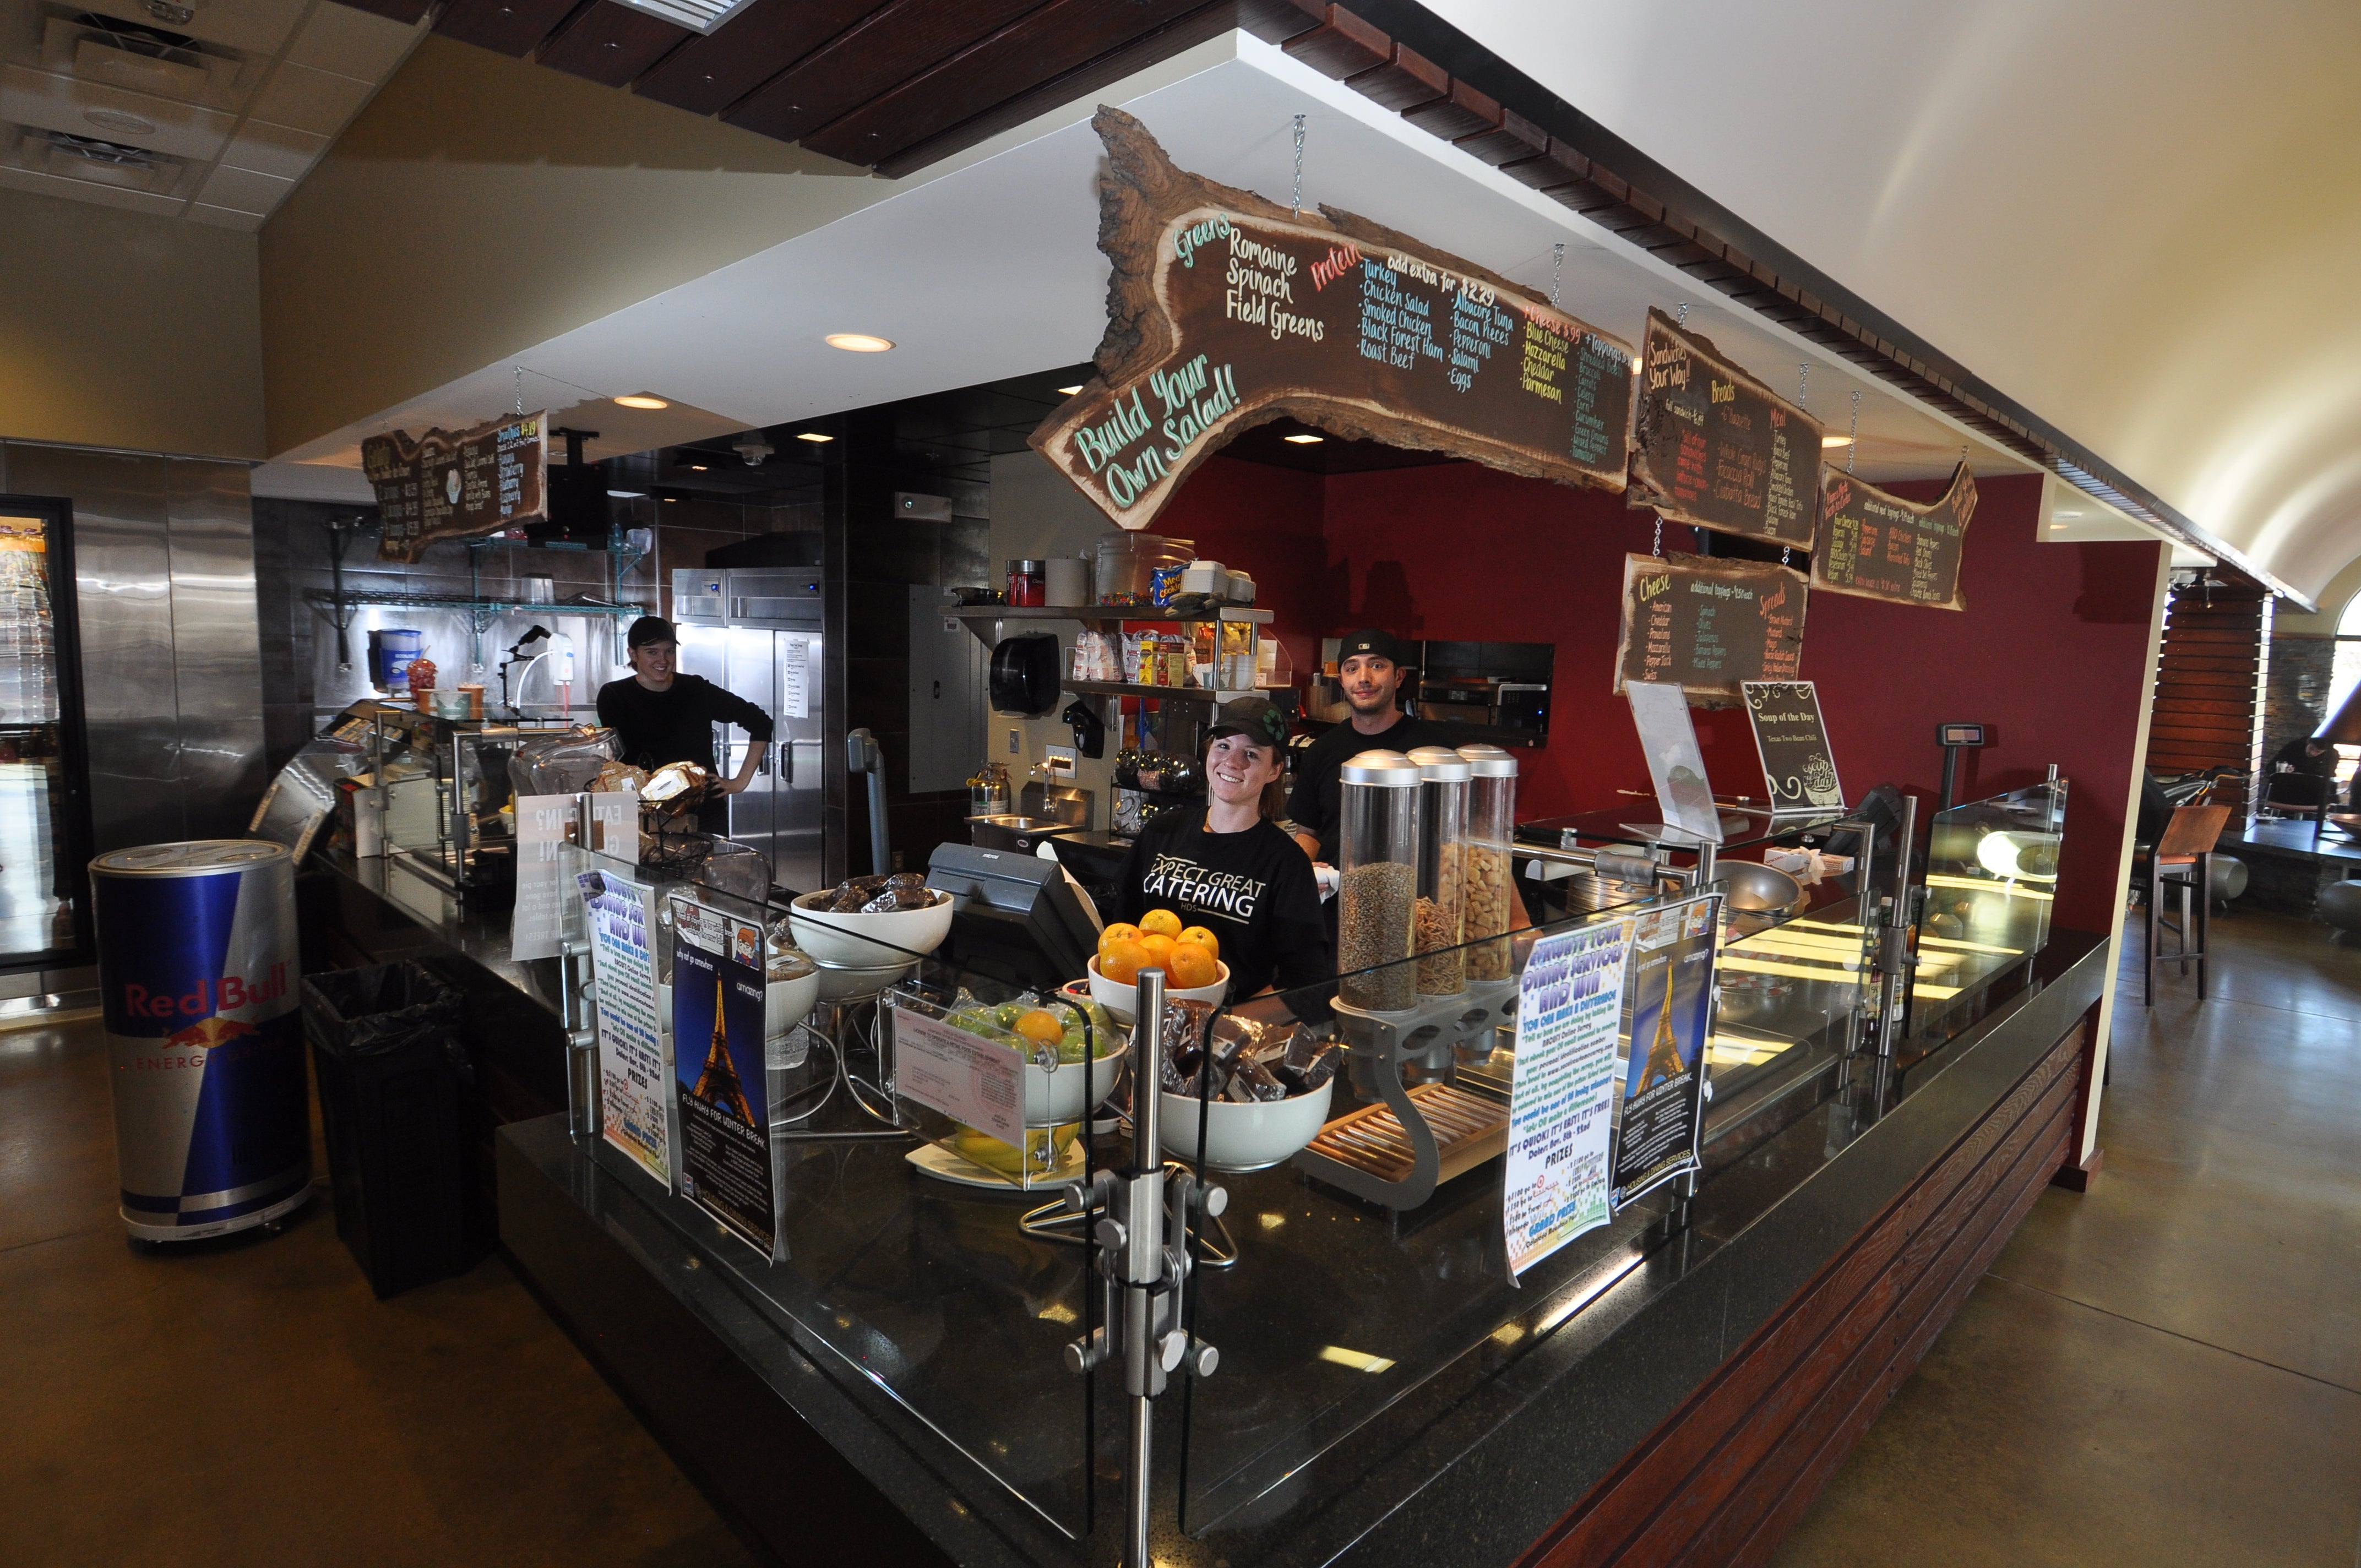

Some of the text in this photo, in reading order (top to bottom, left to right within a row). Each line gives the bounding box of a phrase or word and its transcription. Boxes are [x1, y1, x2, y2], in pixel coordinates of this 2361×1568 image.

[1173, 213, 1231, 268] Greens
[1230, 227, 1297, 276] Romaine
[1226, 257, 1293, 304] Spinach
[1310, 243, 1364, 292] Protein
[1364, 258, 1397, 290] Turkey
[1388, 254, 1495, 307] add extra for $2.29
[1364, 279, 1429, 317] Chicken Salad
[1454, 290, 1513, 331] Albacore Tuna
[1227, 289, 1324, 342] Field Greens
[1362, 298, 1432, 339] Smoked Chicken
[1454, 311, 1509, 346] Bacon Pieces
[1361, 317, 1443, 362] Black Forest Ham
[1453, 329, 1492, 359] Pepperoni
[1526, 320, 1569, 354] Blue Cheese
[1650, 340, 1687, 367] Sandwiches
[1361, 338, 1415, 370] Roast Beef
[1451, 347, 1479, 373] Salami
[1524, 357, 1555, 382] Cheddar
[1525, 341, 1566, 371] Mozzarella
[1450, 367, 1471, 393] Eggs
[1522, 372, 1562, 405] Parmesan
[1649, 367, 1668, 390] Your
[1712, 375, 1735, 404] Breads
[1074, 353, 1208, 473] Build Your
[1107, 363, 1241, 508] Own Salad!
[1640, 574, 1671, 602] Cheese
[1758, 712, 1815, 723] Soup of the Day
[1151, 858, 1266, 898] EXPECT GREAT
[1144, 873, 1255, 917] CATERING
[1180, 902, 1197, 912] HDS
[599, 932, 611, 945] YOU
[609, 914, 629, 940] AND
[1529, 935, 1586, 966] EVALUATE
[1590, 923, 1623, 948] YOUR
[689, 956, 694, 965] go
[694, 958, 713, 971] somewhere
[1521, 943, 1624, 993] DINING SERVICES
[125, 961, 287, 1018] Red Bull
[737, 982, 763, 1002] amazing?
[1539, 971, 1601, 1014] AND WIN
[1523, 1019, 1538, 1033] YOU
[1556, 1005, 1573, 1021] MAKE
[136, 1054, 219, 1070] ENERGY
[1539, 1037, 1606, 1070] personal identification number
[628, 1068, 648, 1090] PRIZES
[683, 1093, 693, 1106] FLY
[694, 1100, 709, 1115] AWAY
[710, 1109, 722, 1124] FOR
[722, 1115, 745, 1136] WINTER
[1523, 1107, 1540, 1122] could
[1541, 1105, 1549, 1114] be
[1550, 1101, 1560, 1111] one
[1624, 1104, 1633, 1117] FLY
[1633, 1095, 1645, 1110] AWAY
[1646, 1090, 1655, 1102] FOR
[1656, 1079, 1674, 1096] WINTER
[1509, 1142, 1521, 1158] IT'S
[1551, 1121, 1563, 1136] IT'S
[1581, 1107, 1593, 1119] IT'S
[1594, 1098, 1610, 1114] FREE!
[1548, 1111, 1563, 1123] make
[1545, 1143, 1573, 1169] PRIZES
[1650, 1160, 1665, 1174] DINING
[1666, 1149, 1691, 1166] SERVICES
[1529, 1200, 1576, 1237] GRAND PRIZE
